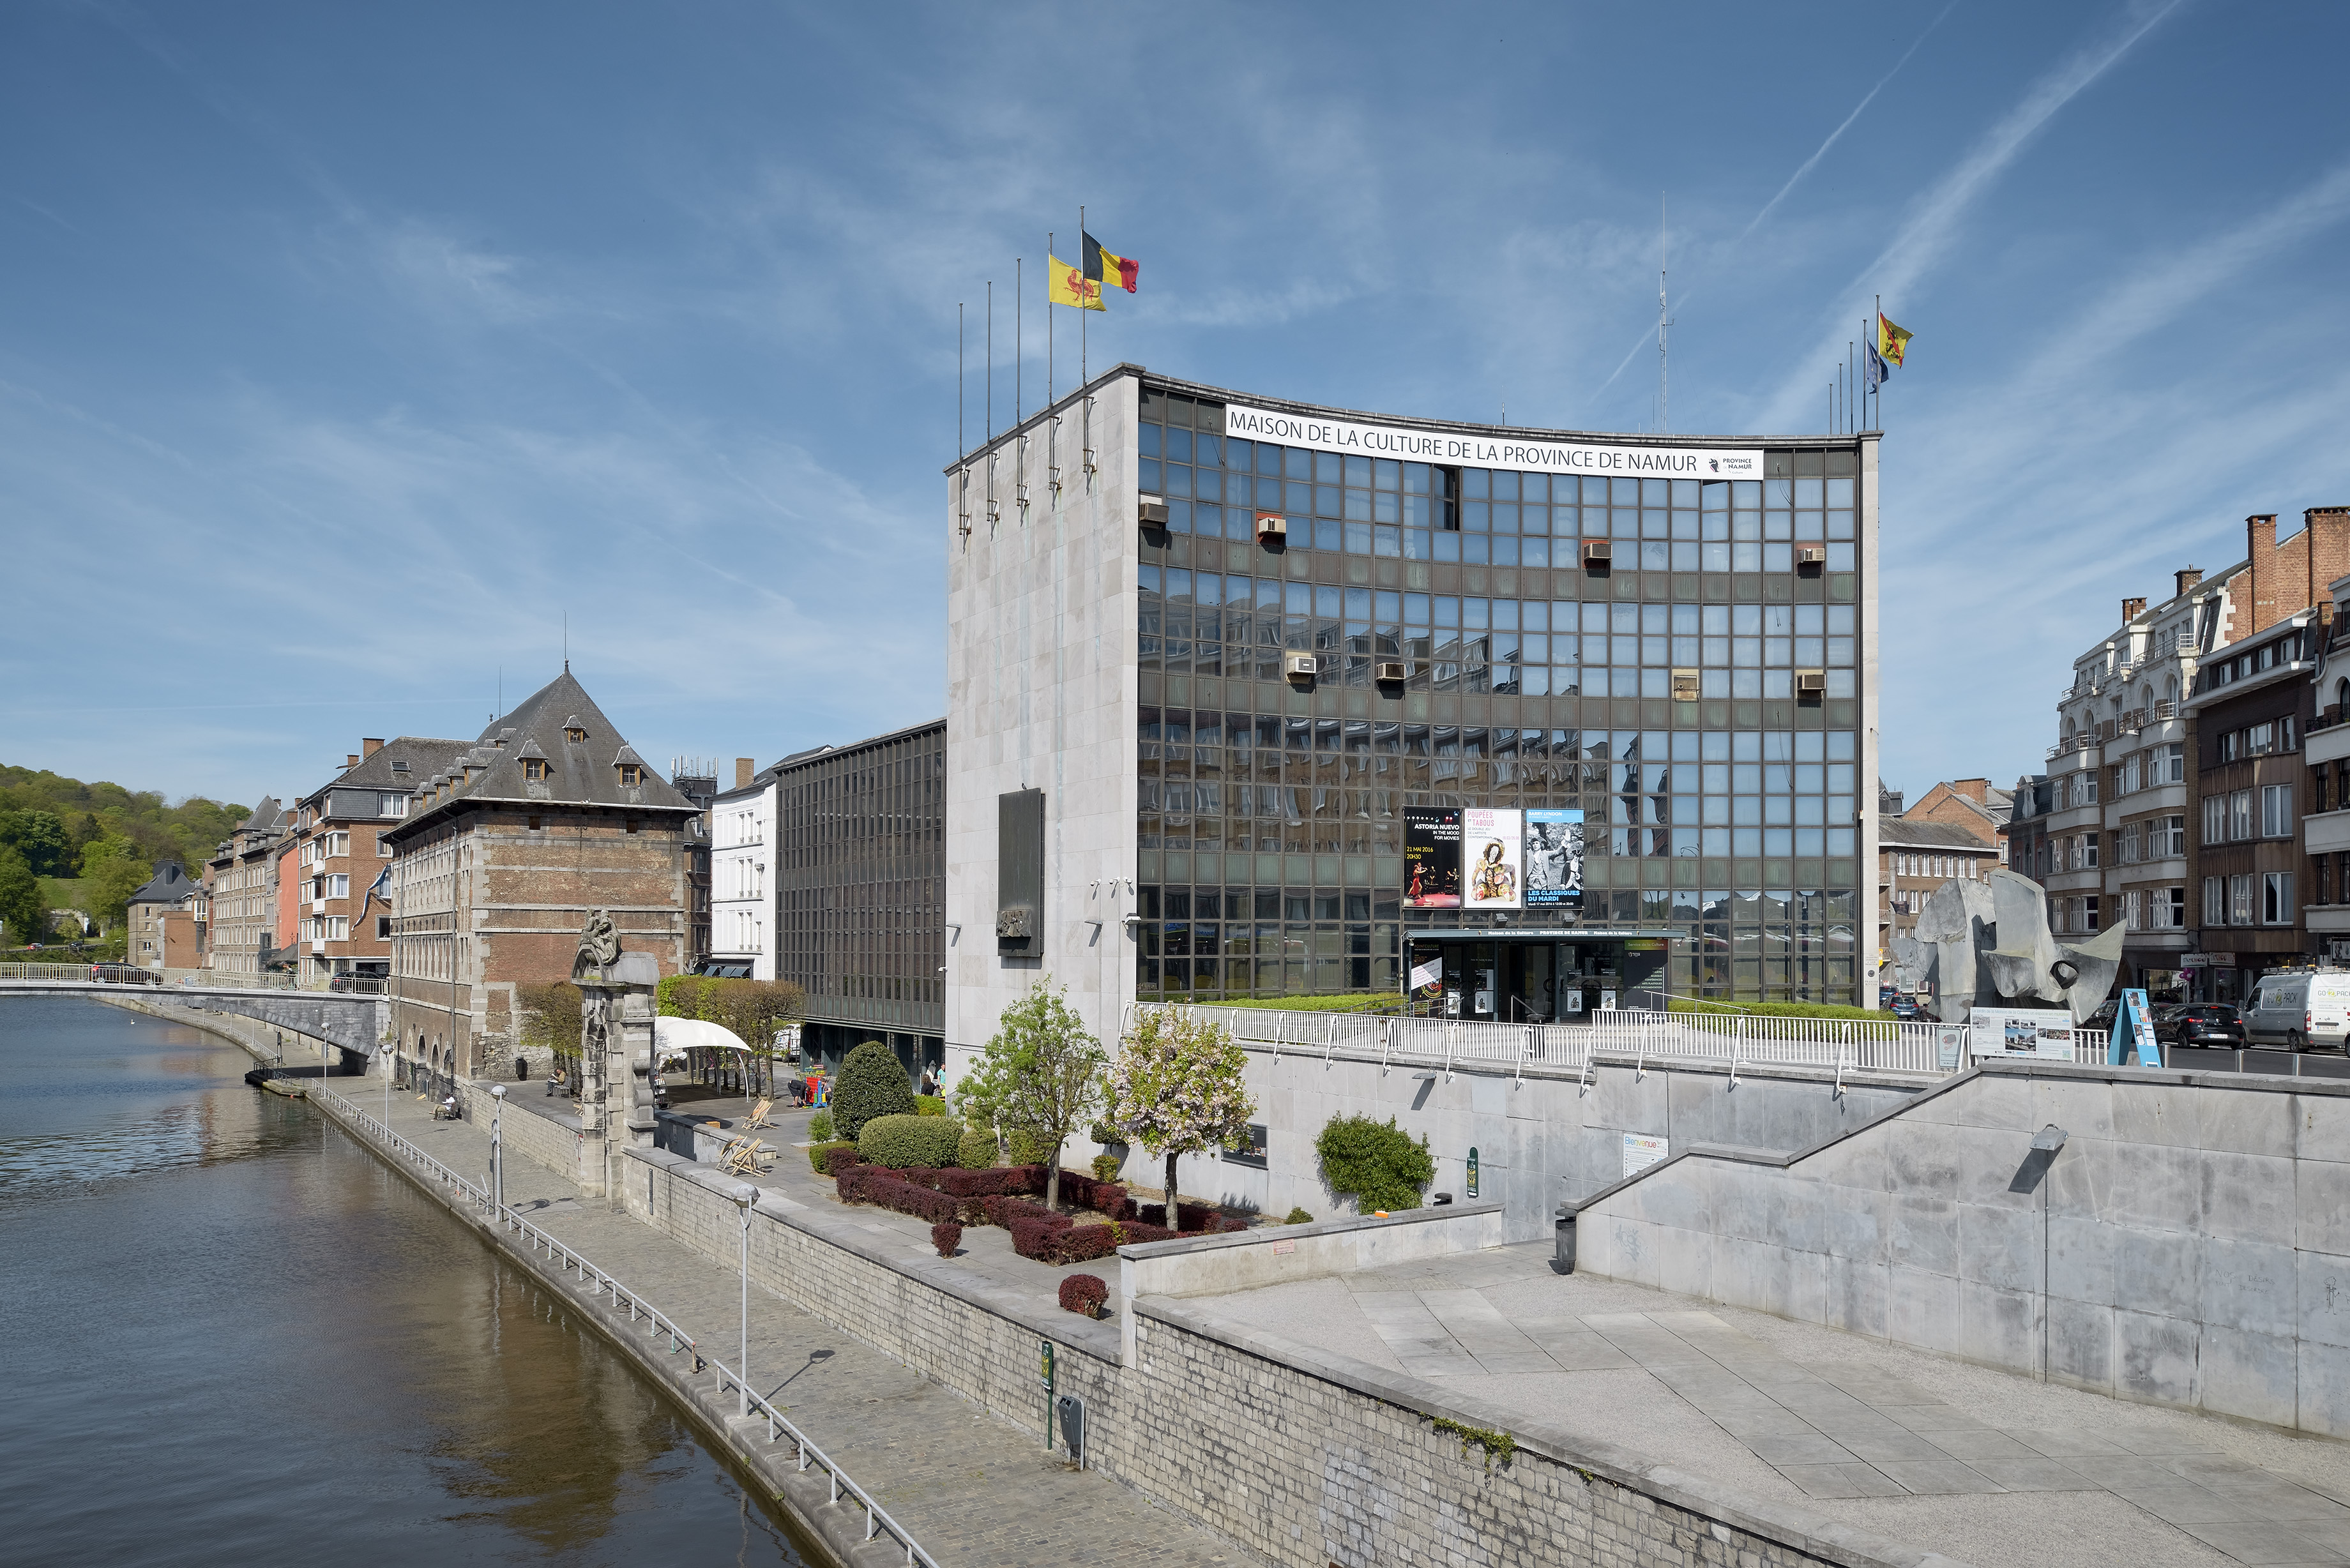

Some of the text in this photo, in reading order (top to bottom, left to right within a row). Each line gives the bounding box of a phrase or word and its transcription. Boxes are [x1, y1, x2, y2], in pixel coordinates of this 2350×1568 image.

[1230, 411, 1697, 471] MAISON DE LA CULTURE DE LA PROVINCE DE NAMUR
[1467, 810, 1493, 818] POUPÉES
[2283, 992, 2298, 1003] PACK
[1625, 1136, 1656, 1148] Bienvenue
[2215, 1269, 2236, 1279] NOS
